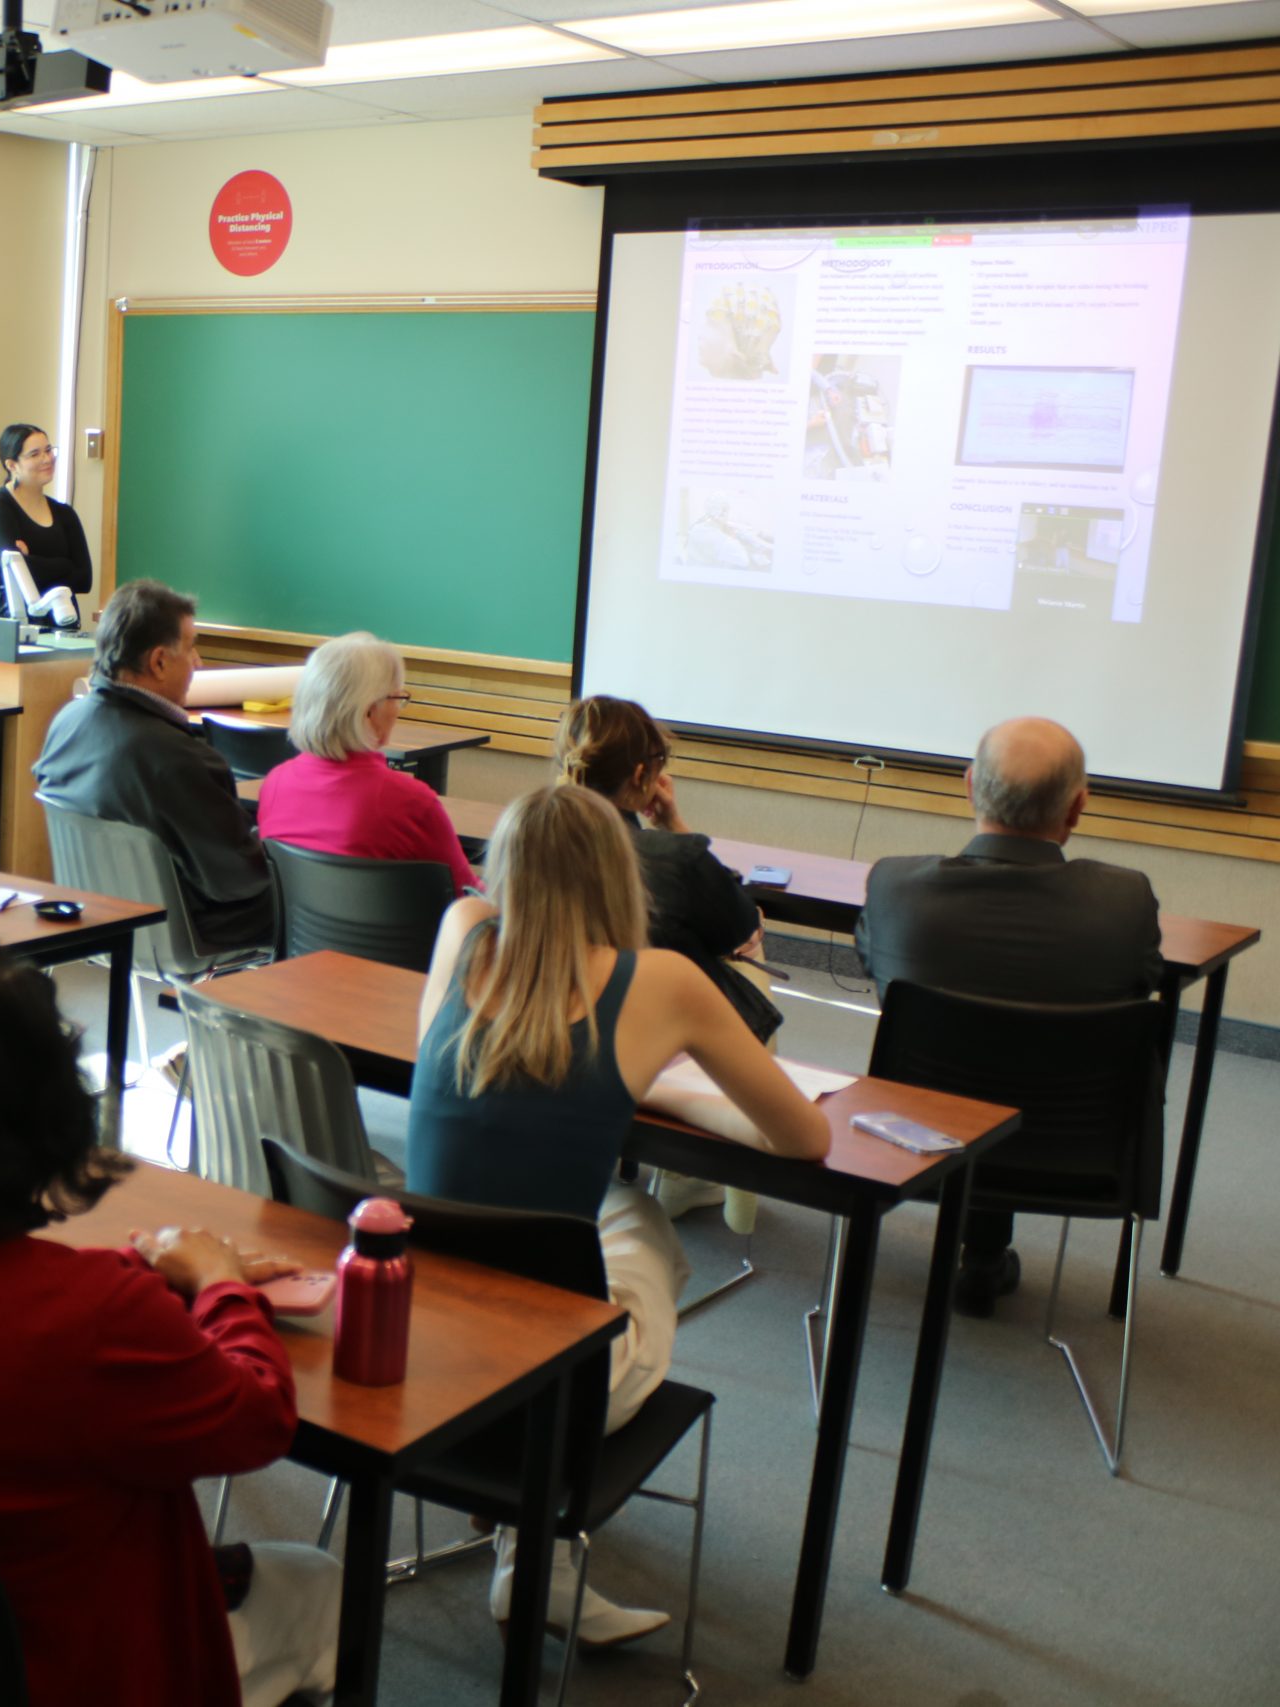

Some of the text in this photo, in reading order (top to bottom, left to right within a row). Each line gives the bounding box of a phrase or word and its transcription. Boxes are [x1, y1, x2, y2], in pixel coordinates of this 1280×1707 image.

[218, 211, 283, 223] Practice Physical
[229, 223, 271, 233] Distancing
[695, 262, 759, 271] INTRODUCTION
[821, 259, 892, 268] METHODOLOGY
[967, 345, 1007, 354] RESULTS
[800, 493, 848, 503] MATERIALS
[950, 502, 1013, 513] CONCLUSION
